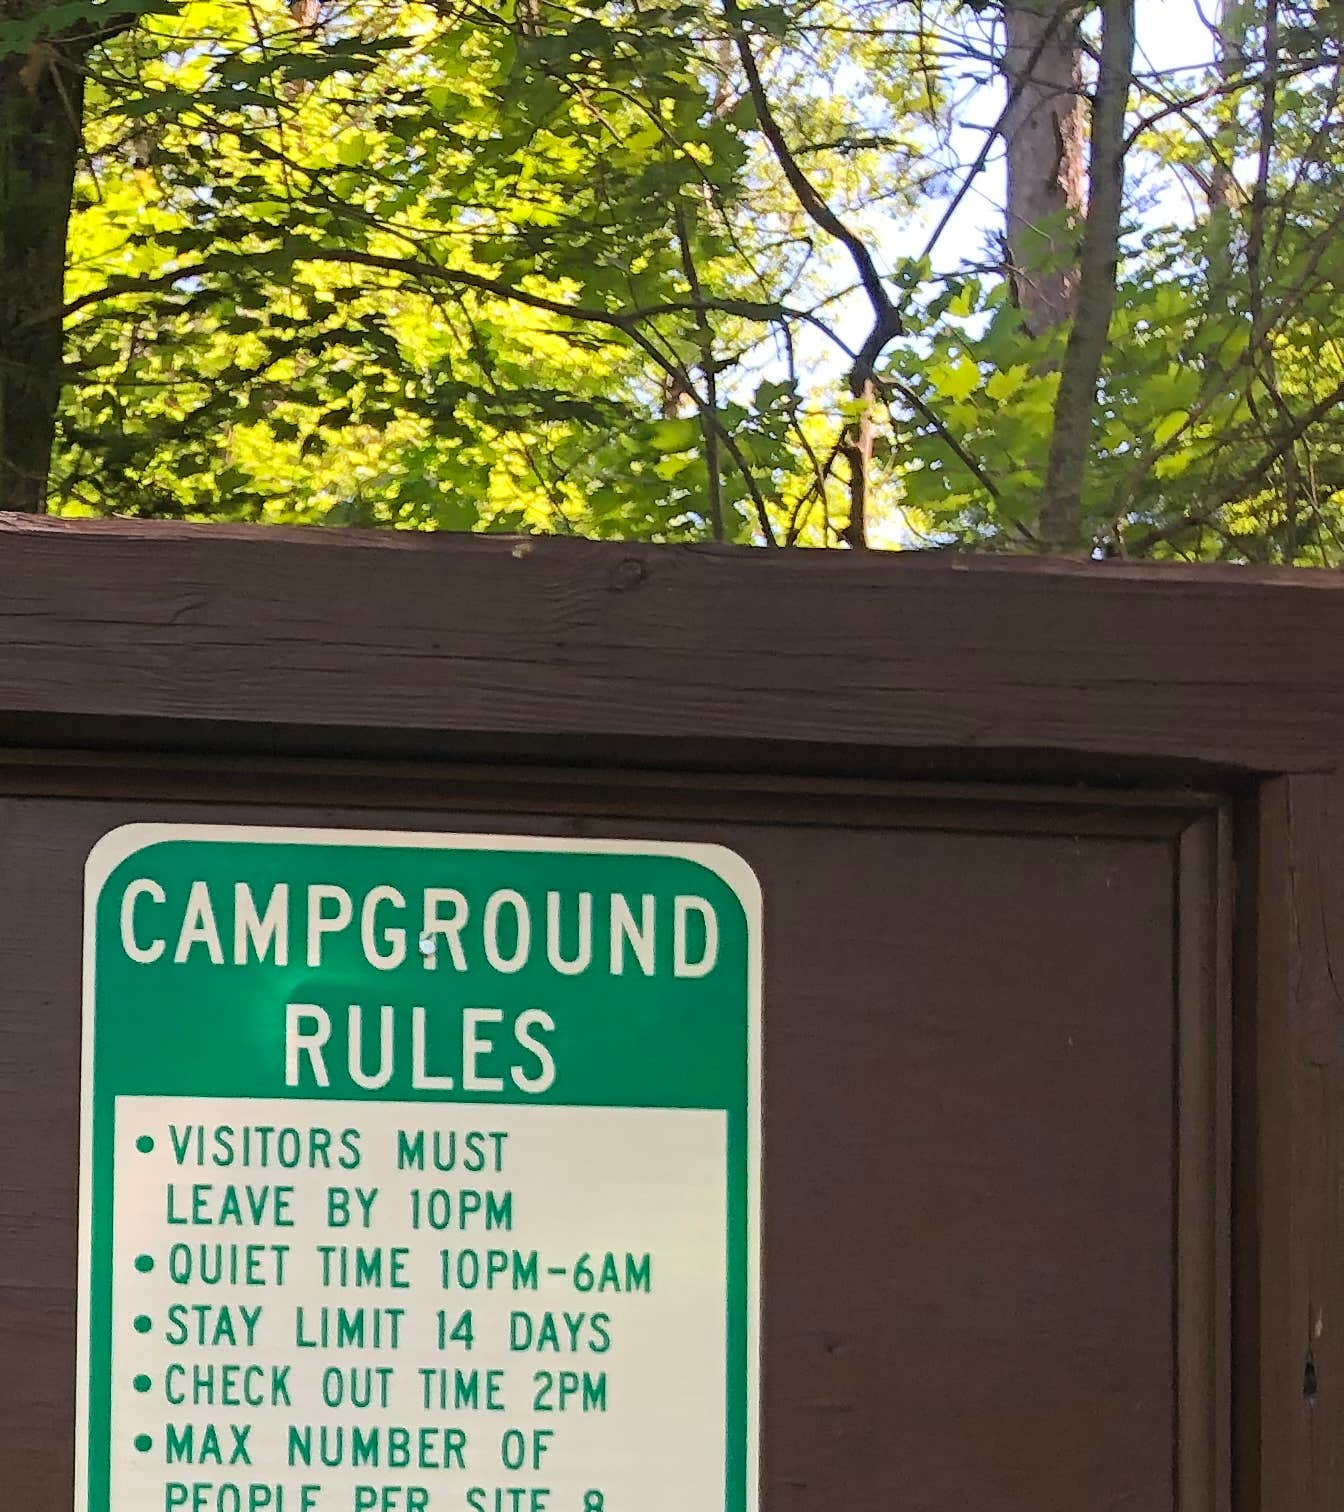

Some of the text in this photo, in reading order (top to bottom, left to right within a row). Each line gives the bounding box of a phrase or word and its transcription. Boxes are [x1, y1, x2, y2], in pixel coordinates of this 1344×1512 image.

[120, 878, 718, 977] CAMPGROUND
[285, 1004, 555, 1094] RULES
[168, 1125, 508, 1172] VISITORS MUST
[167, 1183, 512, 1231] LEAVE BY 10PM
[169, 1243, 651, 1294] QUIET TIME 10PM-6AM
